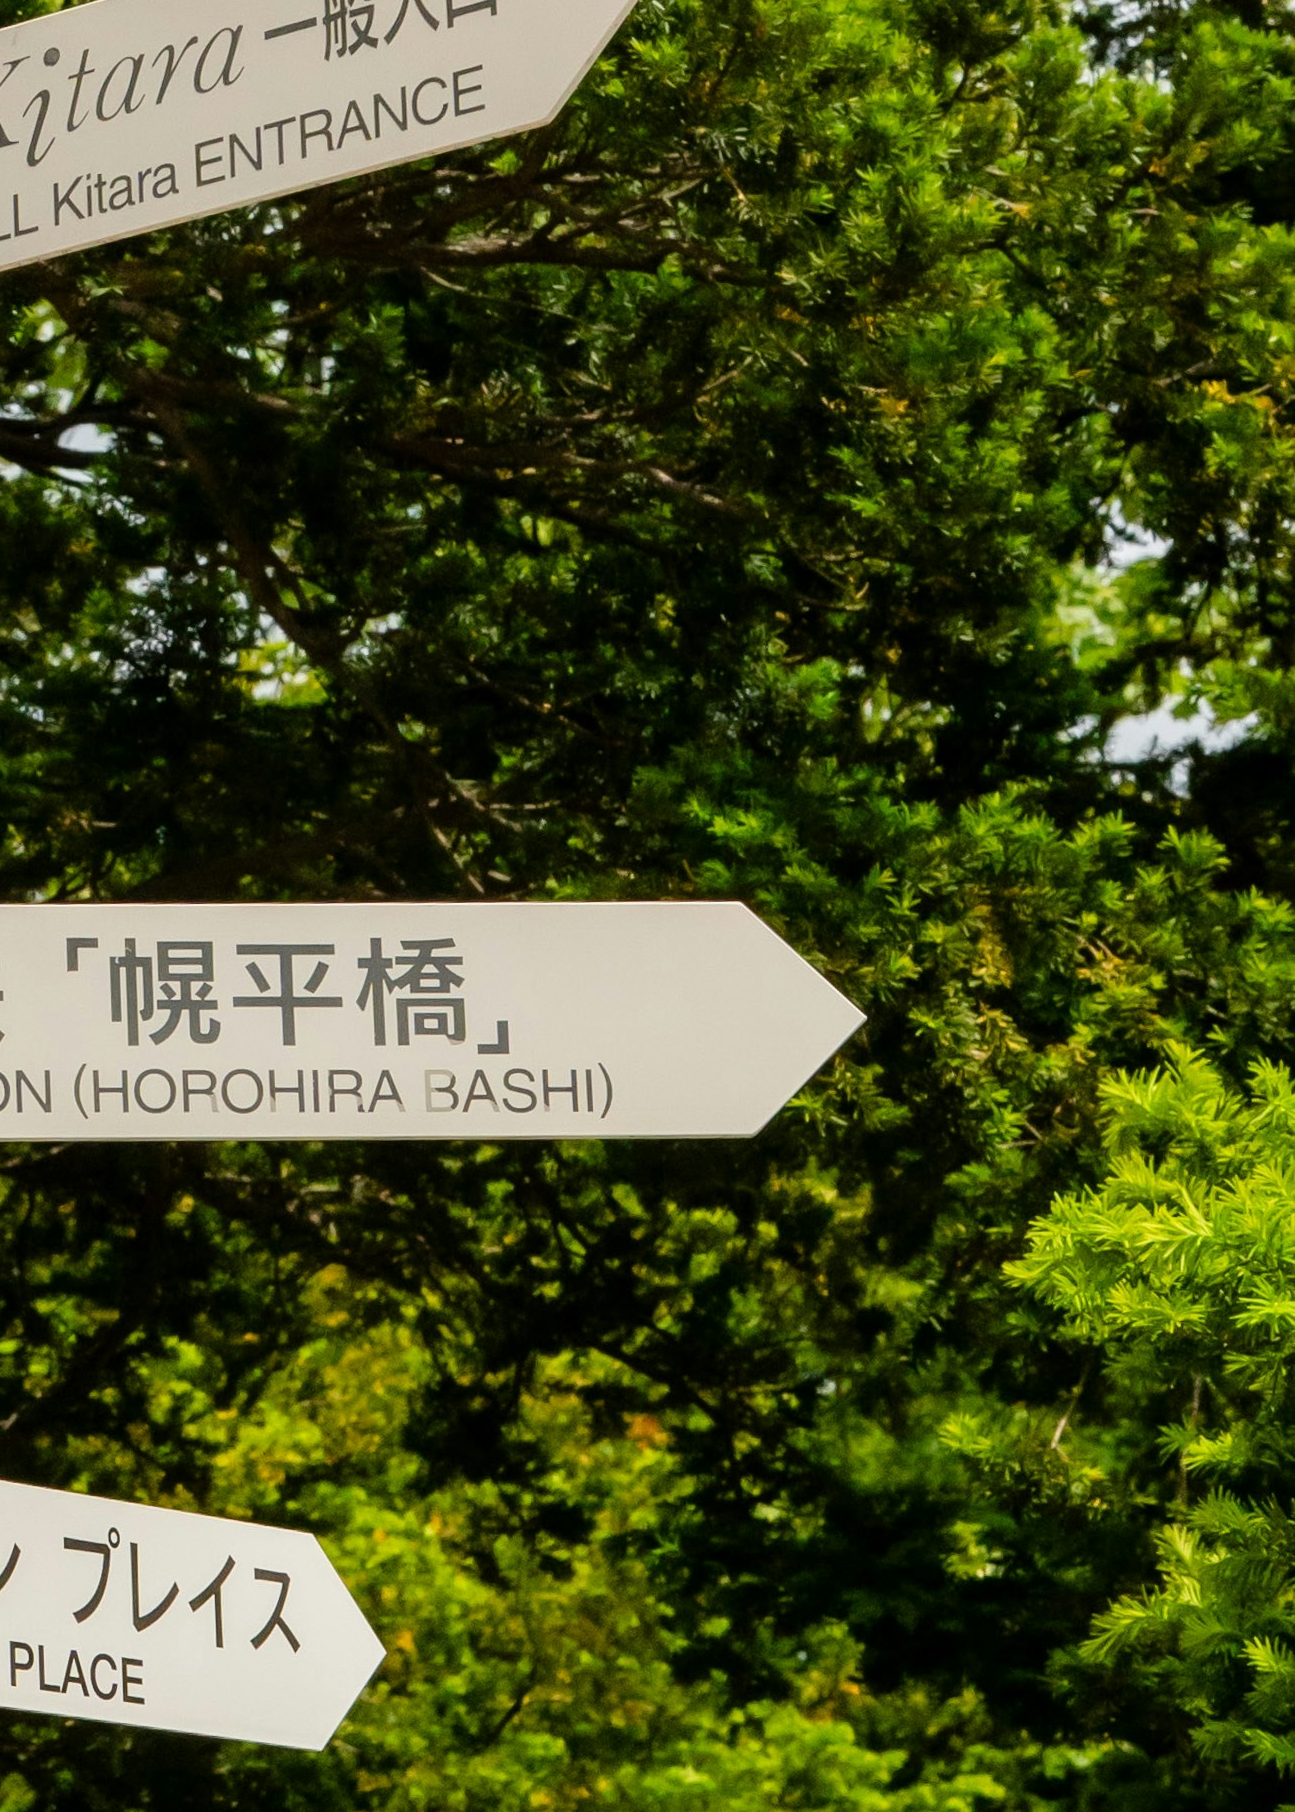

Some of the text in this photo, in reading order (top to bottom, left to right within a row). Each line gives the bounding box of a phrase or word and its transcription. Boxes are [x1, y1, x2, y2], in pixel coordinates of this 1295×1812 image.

[54, 163, 179, 226] Kitara
[195, 65, 485, 187] ENTRANCE
[74, 1064, 403, 1119] (HOROHIRA
[424, 1063, 612, 1118] BASHI)
[64, 1527, 300, 1653] プレイス
[10, 1641, 145, 1704] PLACE
